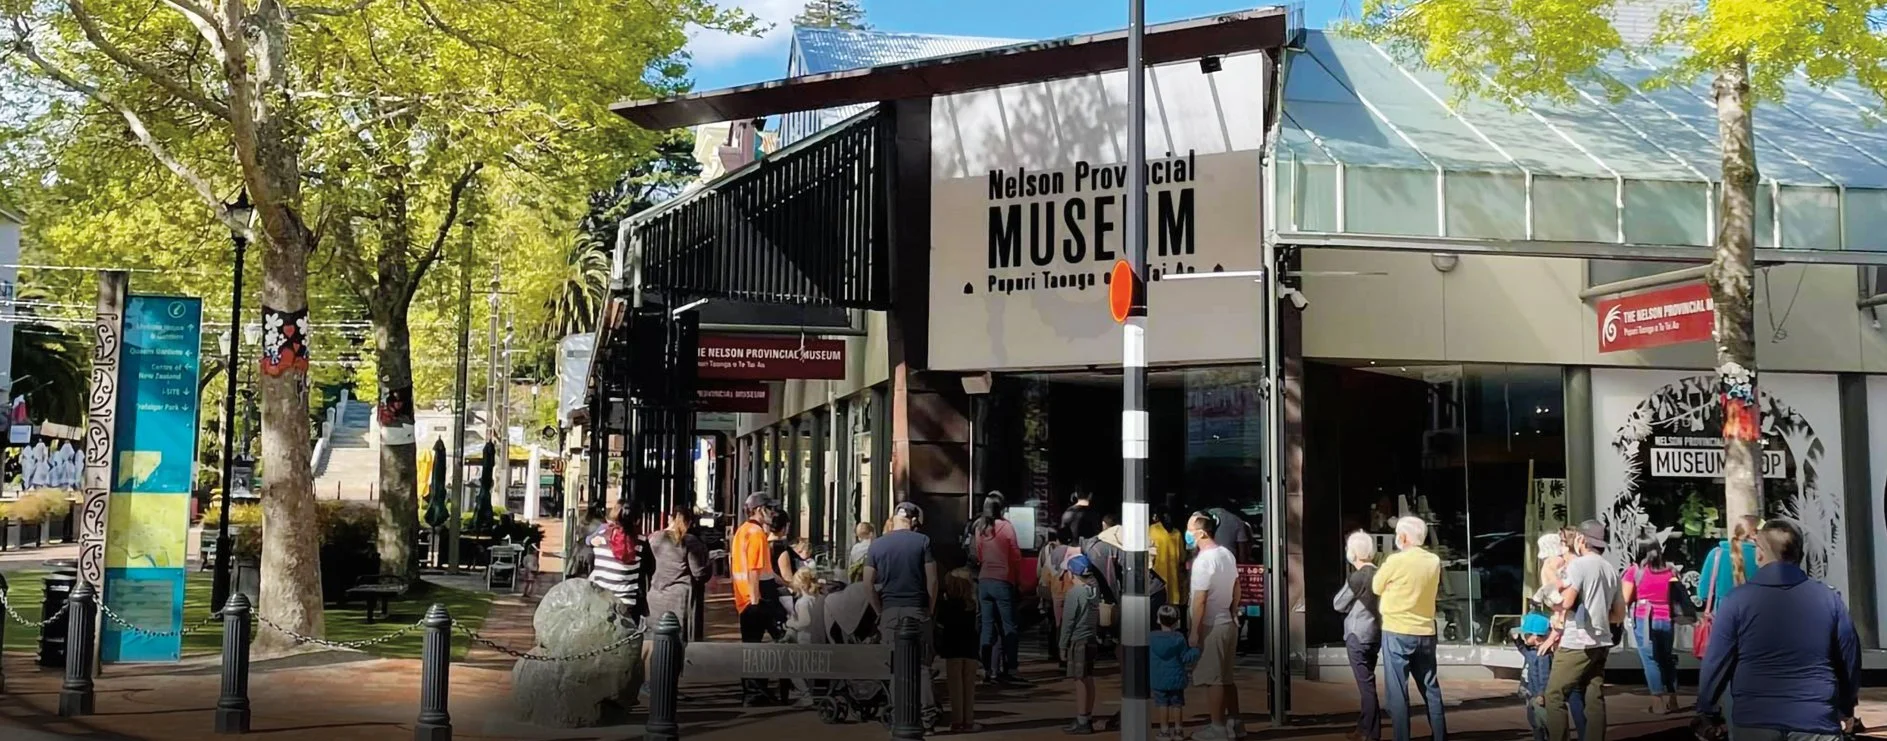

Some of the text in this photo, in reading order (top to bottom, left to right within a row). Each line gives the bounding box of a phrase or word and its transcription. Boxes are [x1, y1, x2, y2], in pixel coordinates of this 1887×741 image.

[988, 149, 1196, 200] Nelson Provcial
[988, 188, 1195, 269] MUSEM
[988, 272, 1036, 296] Pupuri
[1041, 270, 1096, 291] Taonga
[1623, 310, 1637, 324] THE
[1636, 306, 1663, 322] NELSON
[1663, 299, 1706, 318] PROVINCIAL
[708, 347, 744, 358] NELSON
[745, 348, 799, 360] PROVINCIAL
[802, 350, 841, 361] MUSEUM
[735, 390, 766, 399] MUSEUM
[164, 403, 180, 411] Park
[1654, 435, 1683, 446] NELSON
[1656, 451, 1726, 474] MUSEUM
[742, 649, 833, 674] HARDY STREET
